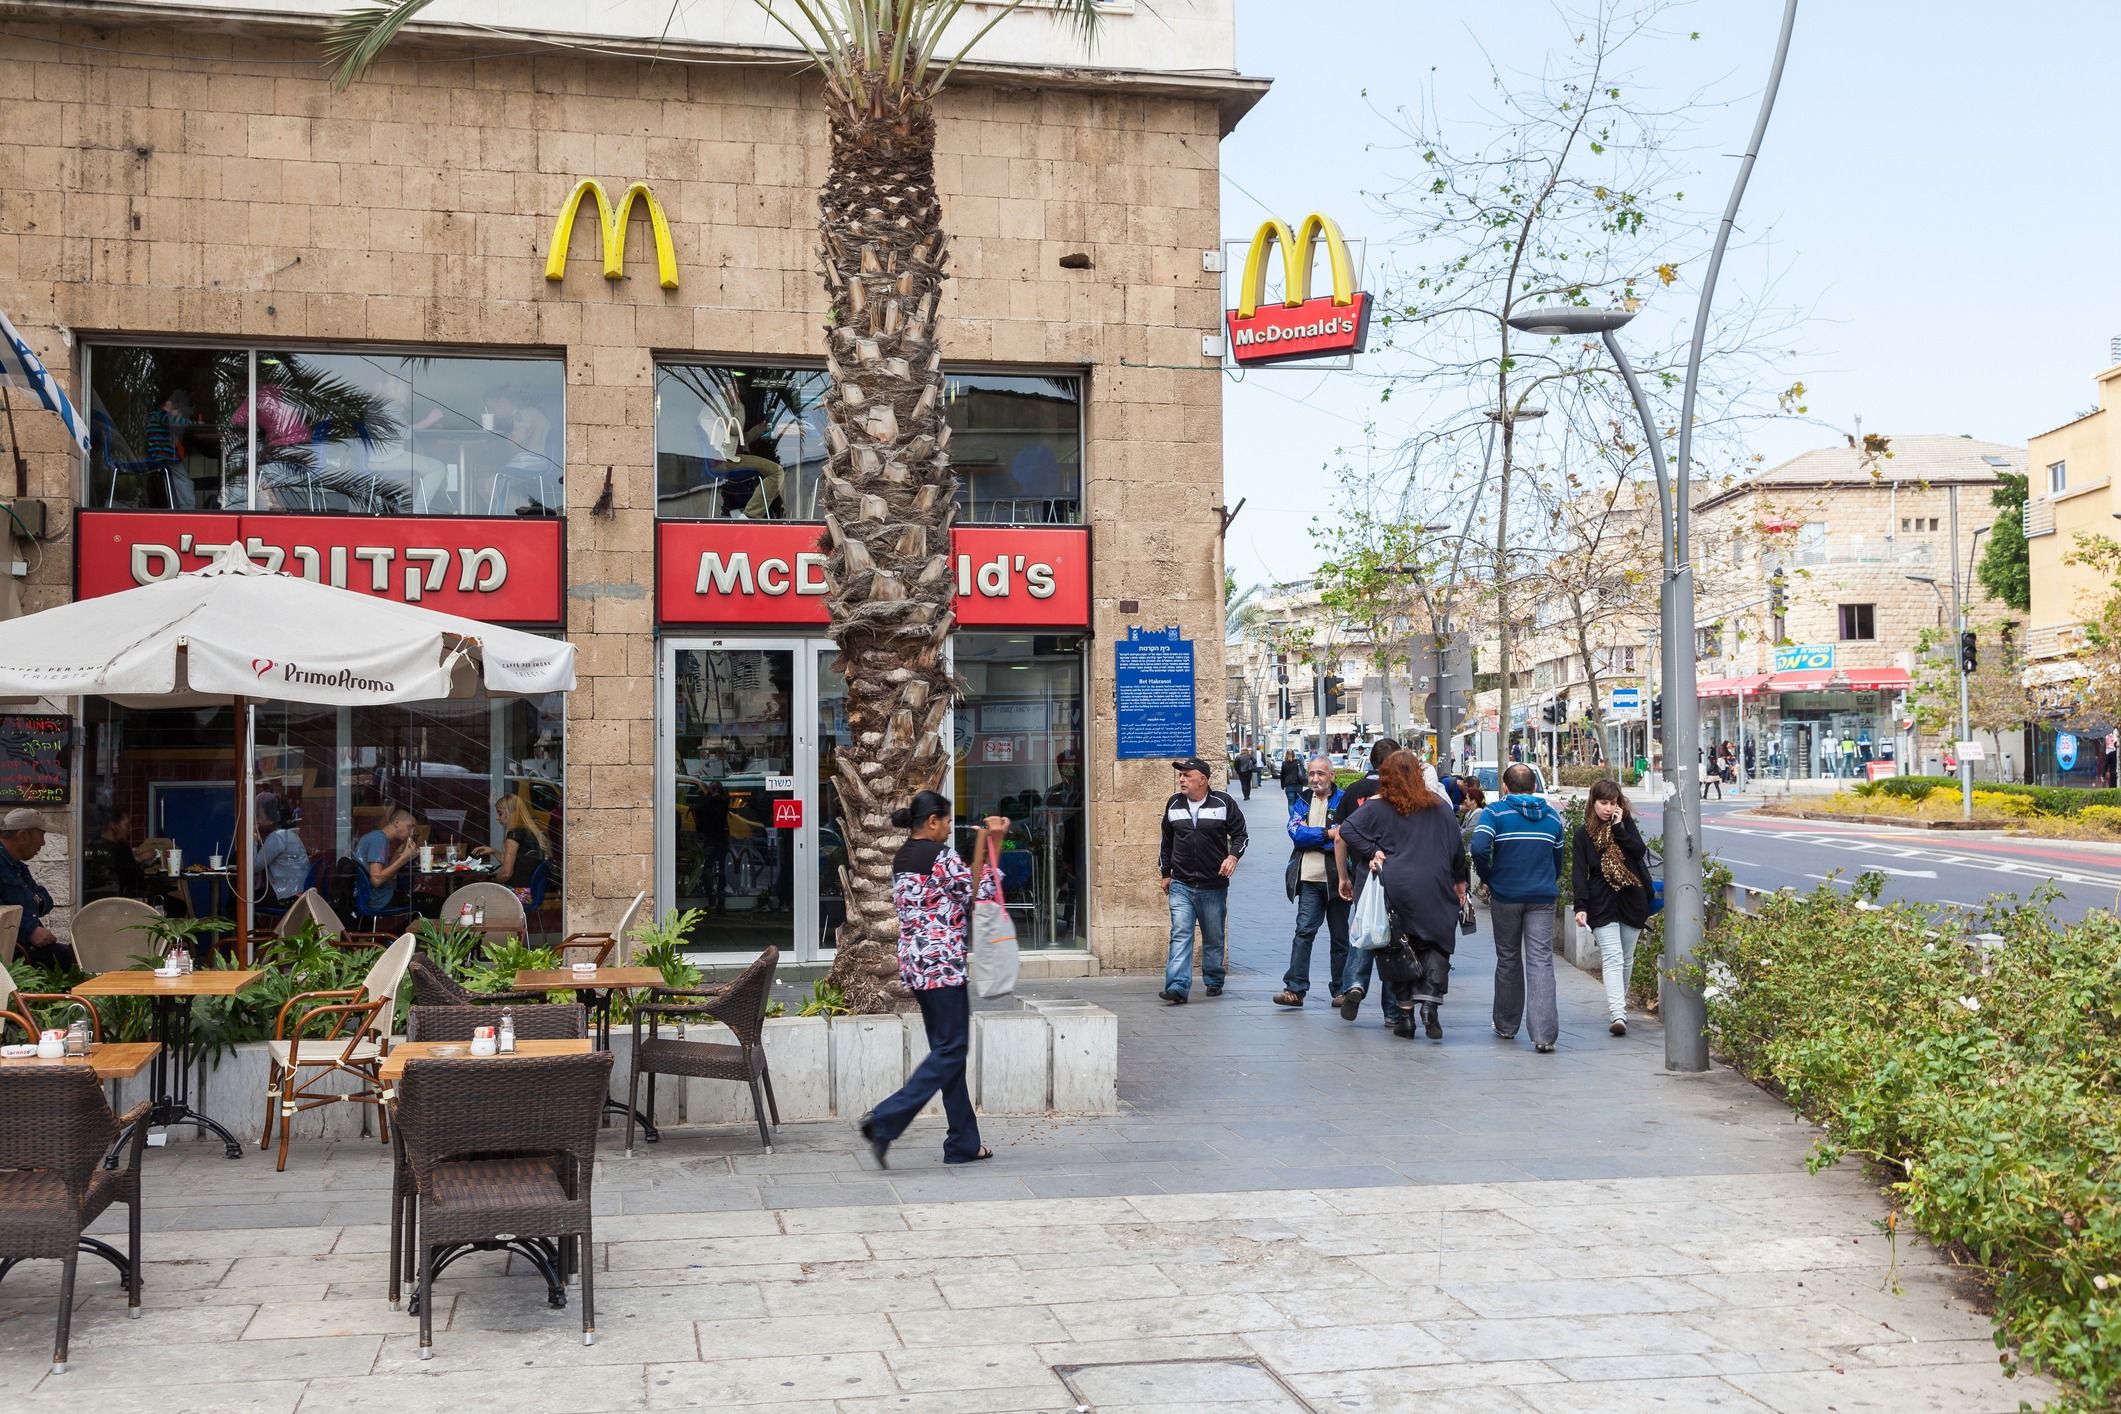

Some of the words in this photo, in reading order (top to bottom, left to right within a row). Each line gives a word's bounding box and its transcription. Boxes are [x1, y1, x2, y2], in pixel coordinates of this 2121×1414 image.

[1235, 317, 1353, 346] McDonald's
[694, 550, 1057, 600] McDld's
[21, 672, 90, 681] TRIESTE
[284, 662, 395, 692] PrimoAroma
[768, 778, 792, 789] משוך
